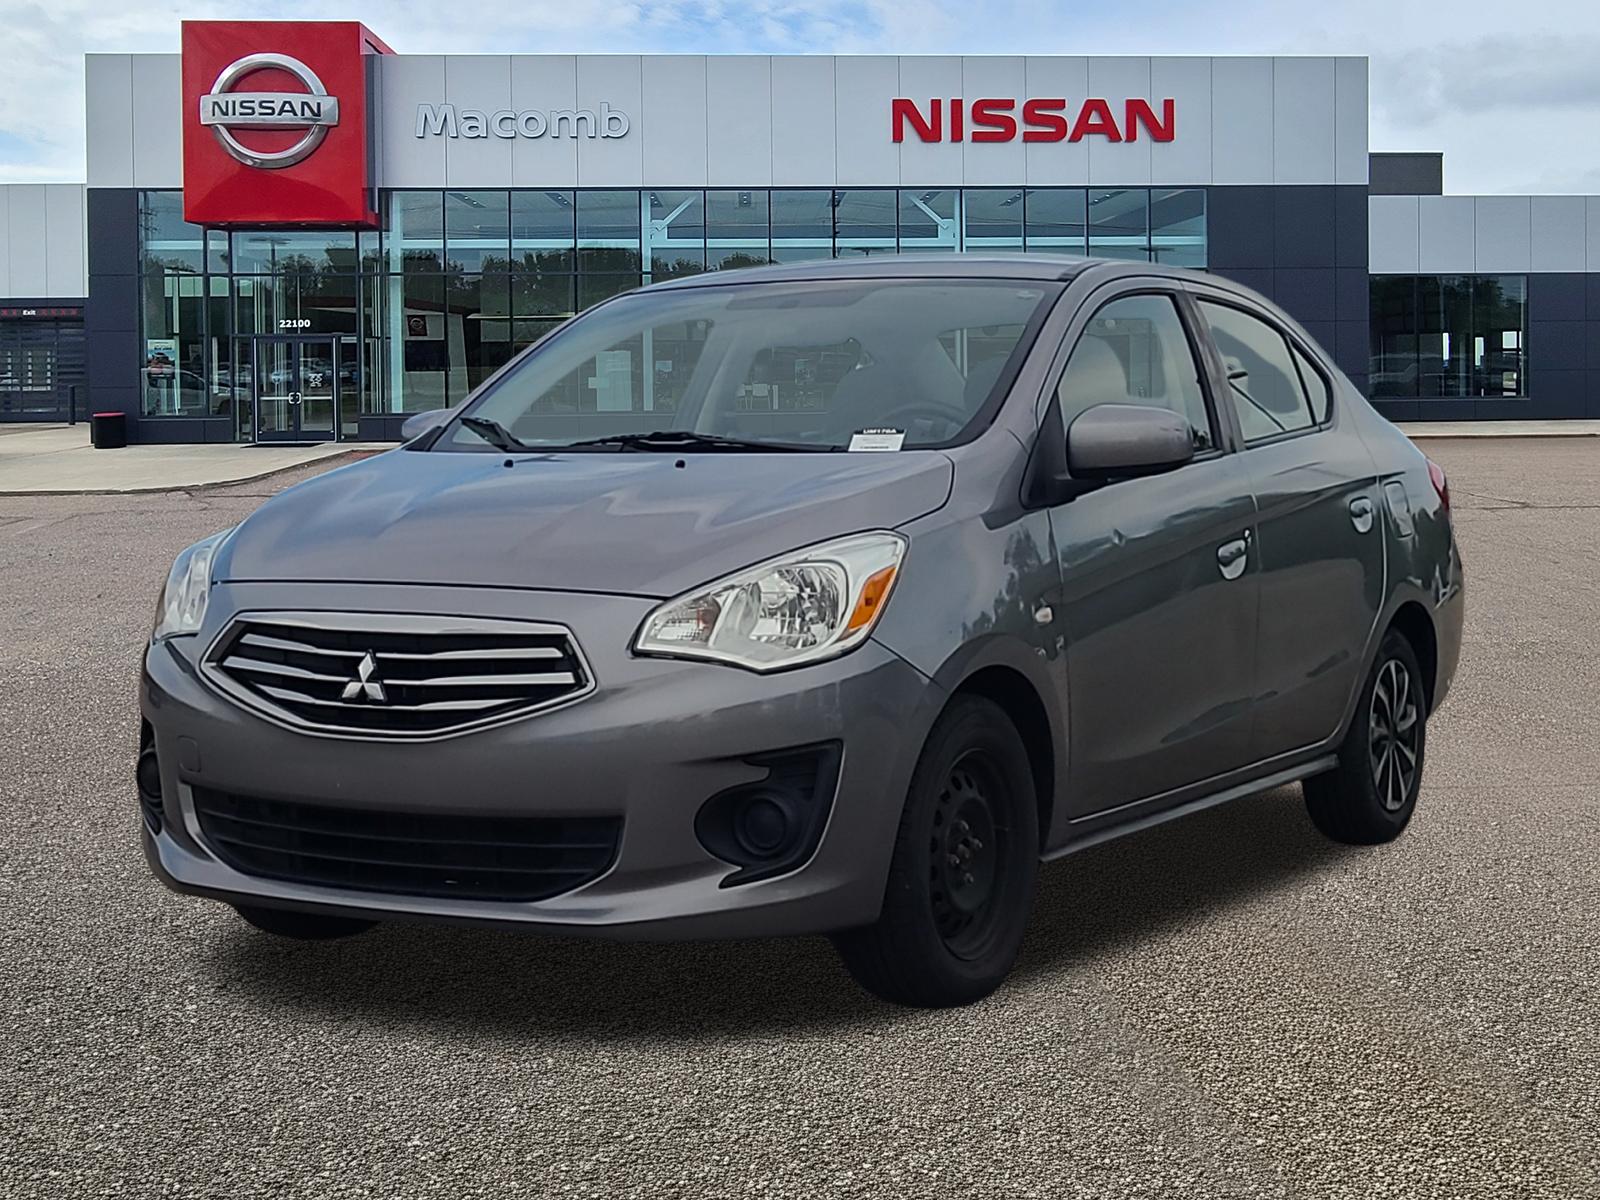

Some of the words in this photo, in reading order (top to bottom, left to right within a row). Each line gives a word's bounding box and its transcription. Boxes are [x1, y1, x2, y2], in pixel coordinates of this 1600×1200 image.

[211, 100, 322, 117] NISSAN
[415, 101, 630, 139] Macomb
[892, 98, 1175, 143] NISSAN
[279, 319, 311, 328] 22100
